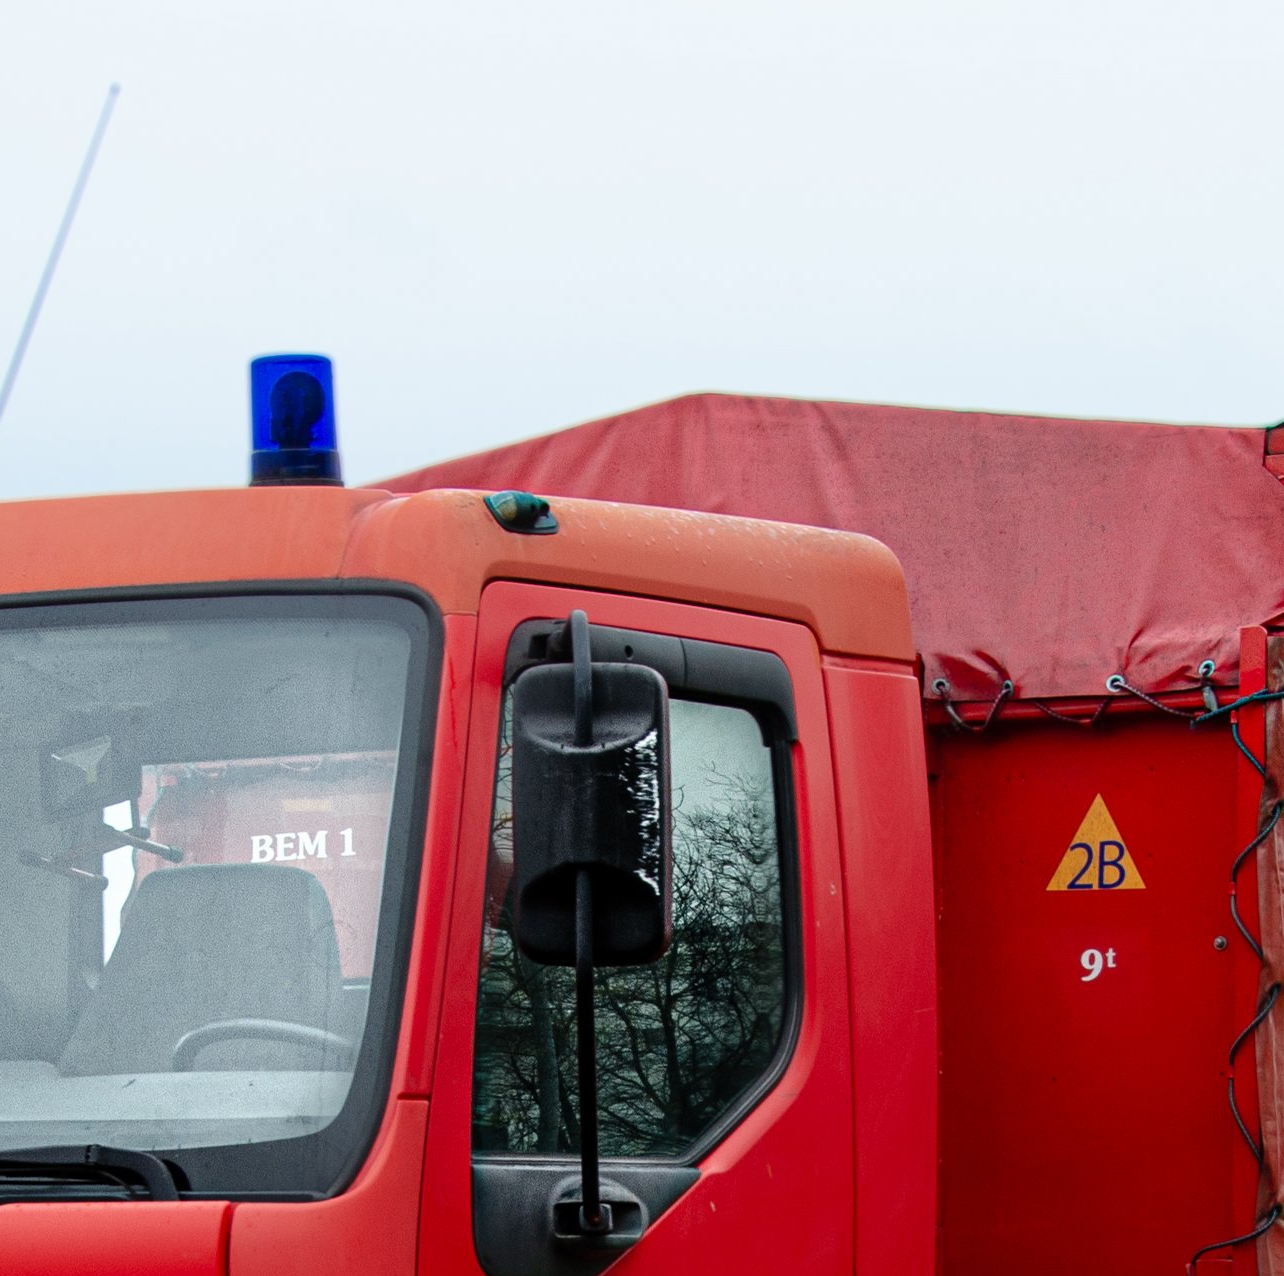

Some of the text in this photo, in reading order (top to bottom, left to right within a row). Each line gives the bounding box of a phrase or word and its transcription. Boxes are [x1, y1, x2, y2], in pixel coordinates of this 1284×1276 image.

[250, 827, 357, 863] BEM 1
[1066, 840, 1126, 889] 2B
